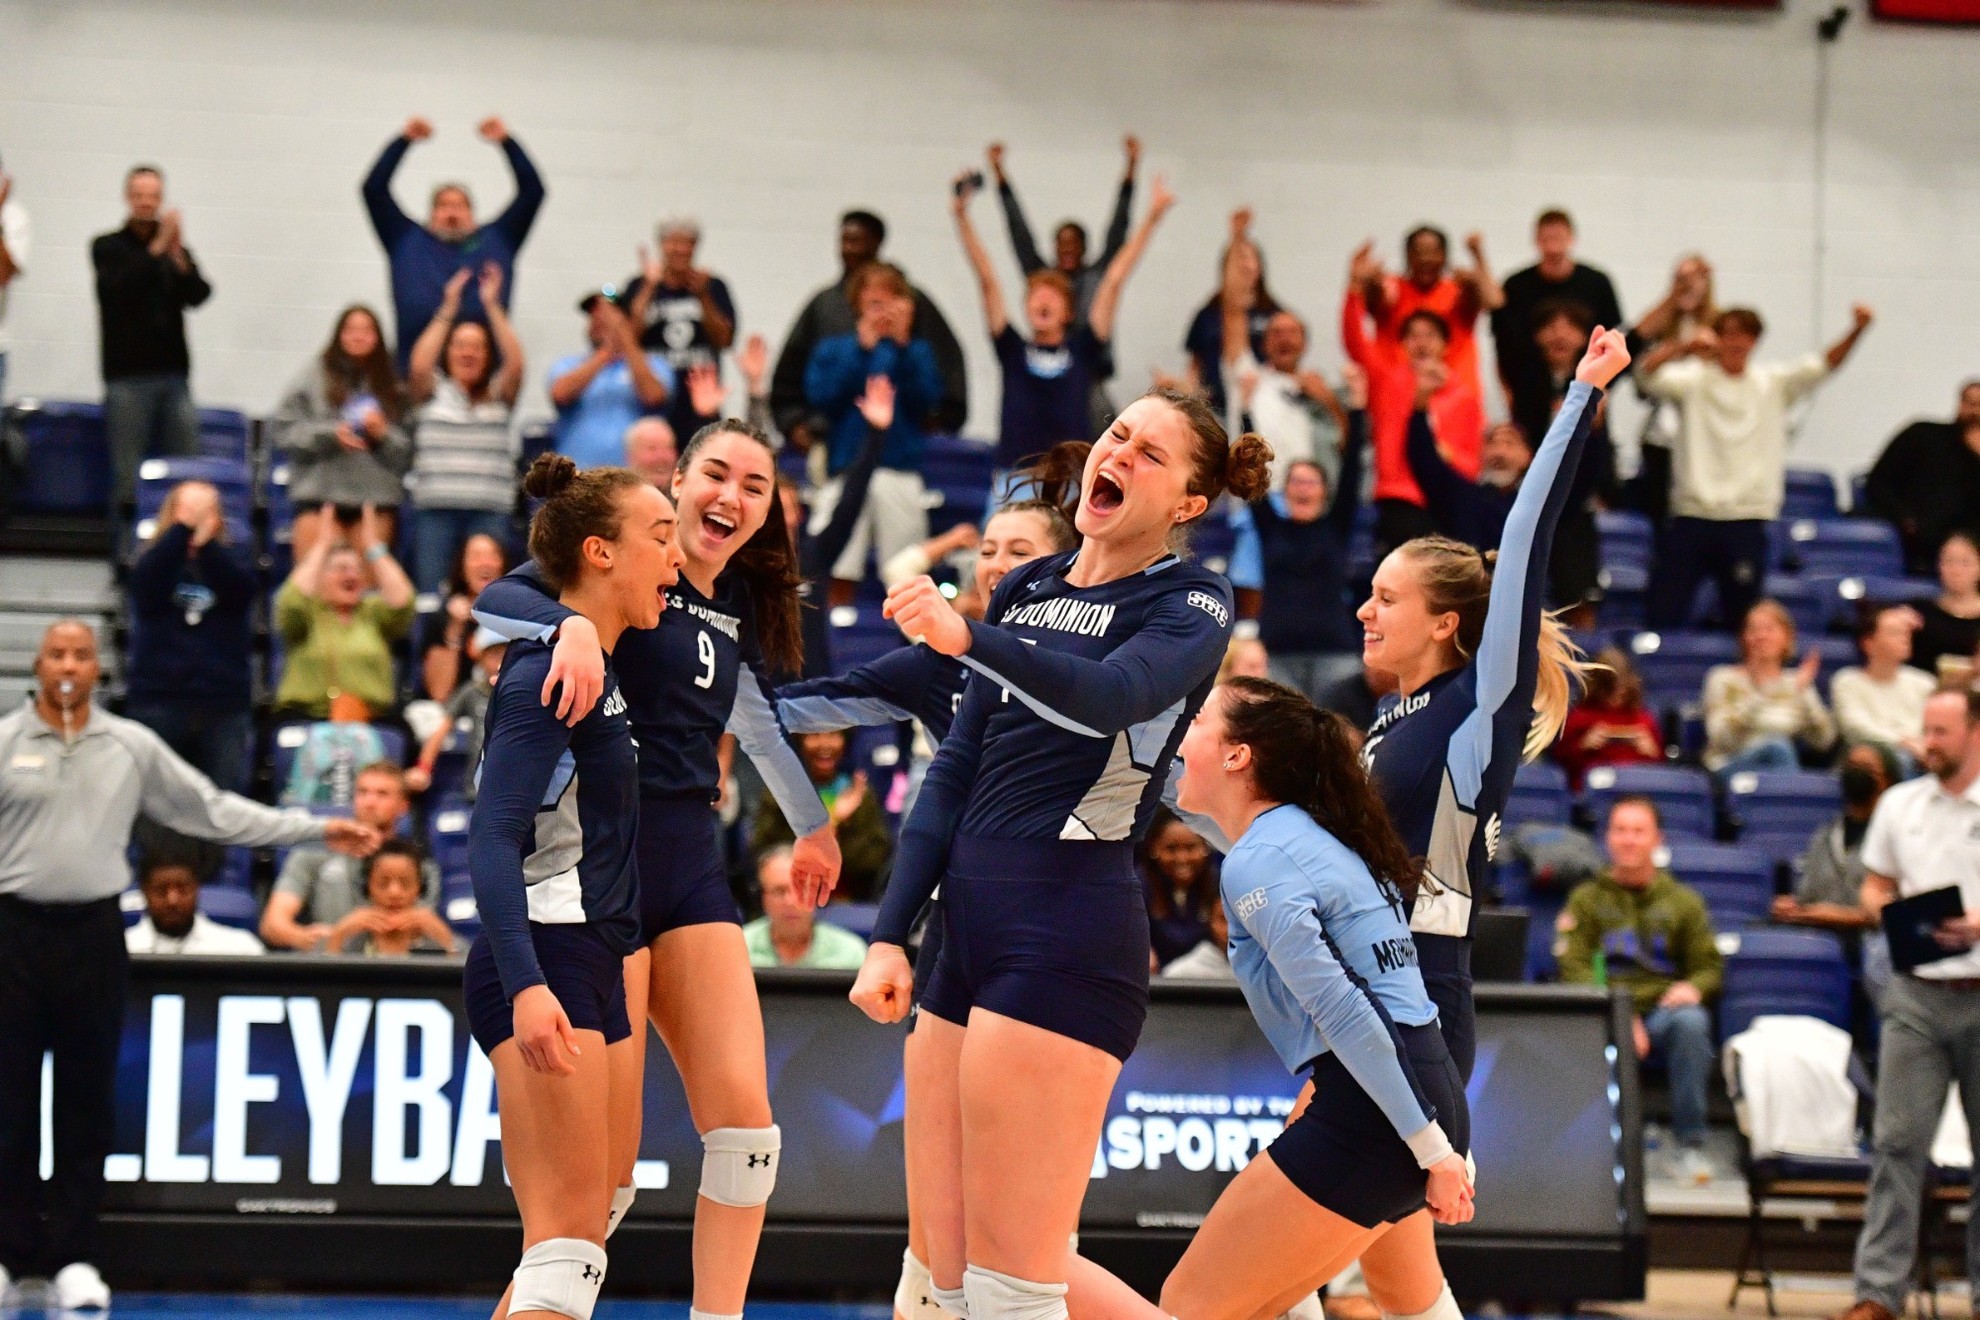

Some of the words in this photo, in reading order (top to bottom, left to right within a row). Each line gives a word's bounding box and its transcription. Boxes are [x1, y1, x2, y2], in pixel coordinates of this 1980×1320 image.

[1014, 598, 1116, 638] DOMINION
[694, 630, 715, 689] 9
[1091, 1114, 1286, 1179] SPORT
